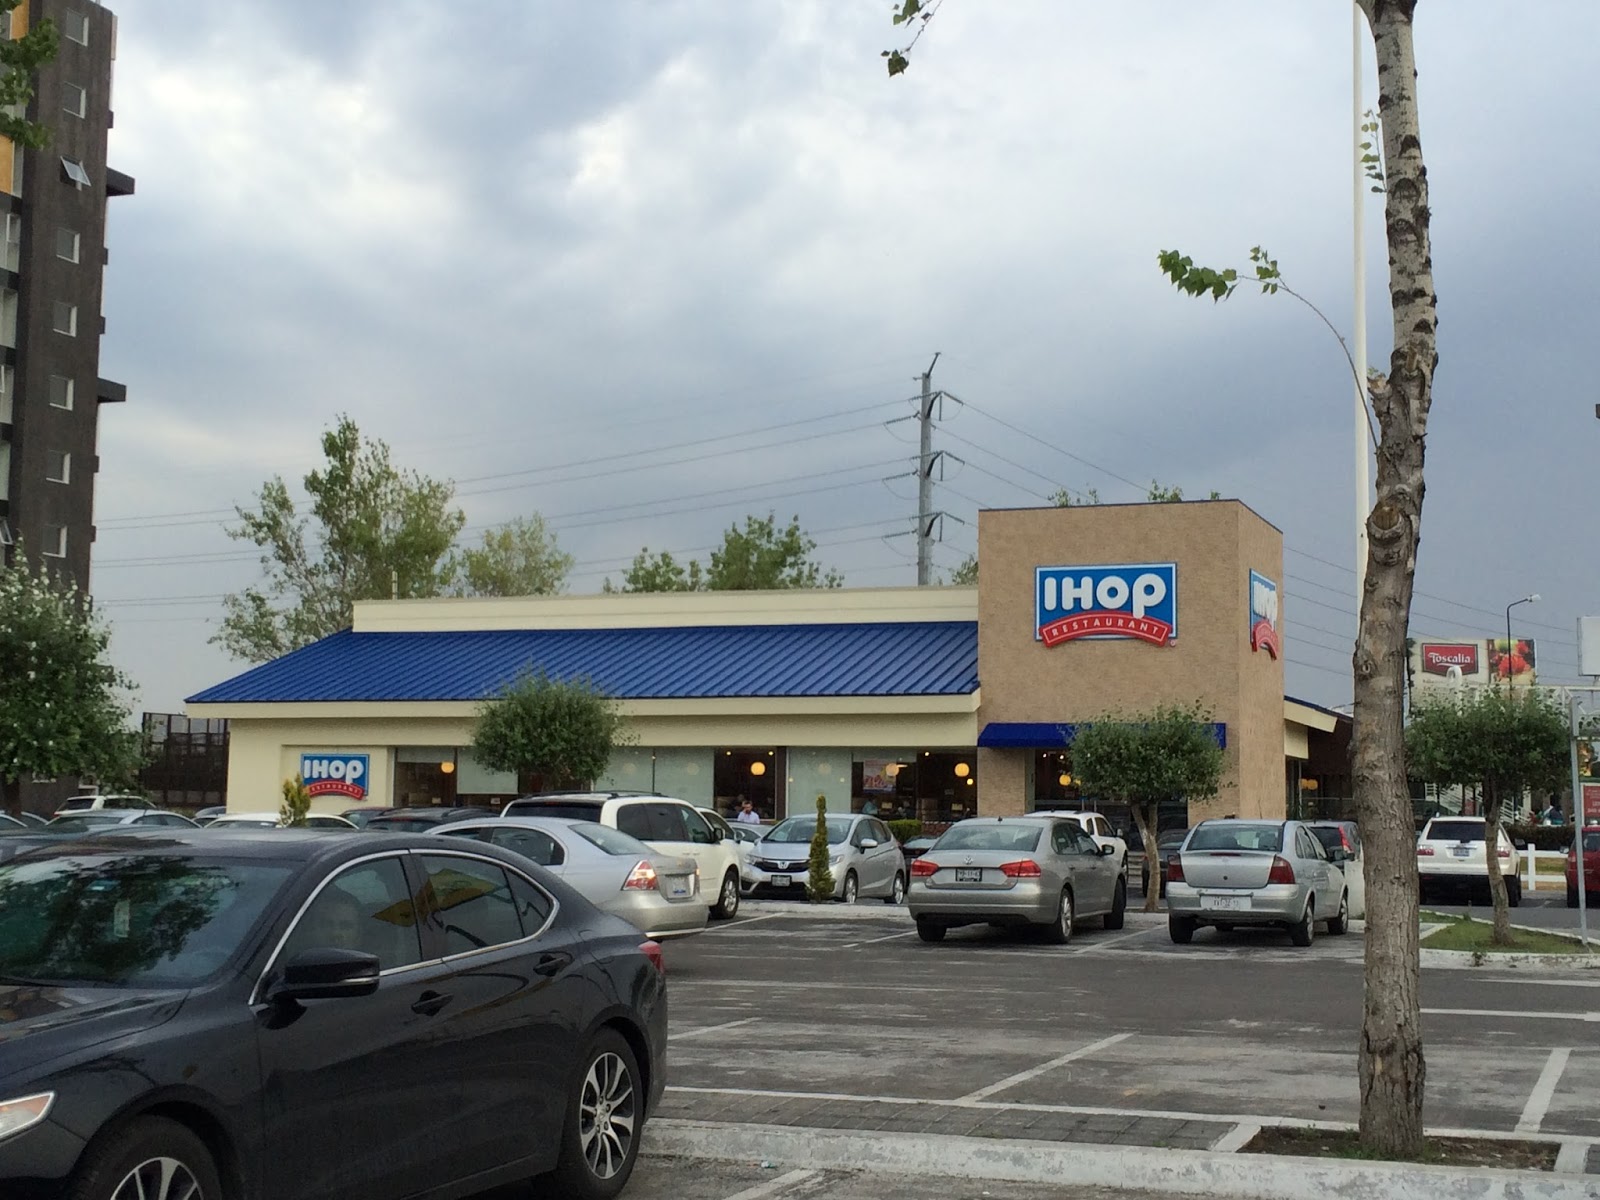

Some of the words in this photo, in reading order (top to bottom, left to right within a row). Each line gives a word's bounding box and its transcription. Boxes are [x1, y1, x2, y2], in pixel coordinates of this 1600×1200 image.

[1044, 573, 1167, 619] IHOP
[1051, 618, 1160, 637] RESTAURANT
[303, 759, 364, 785] IHOP
